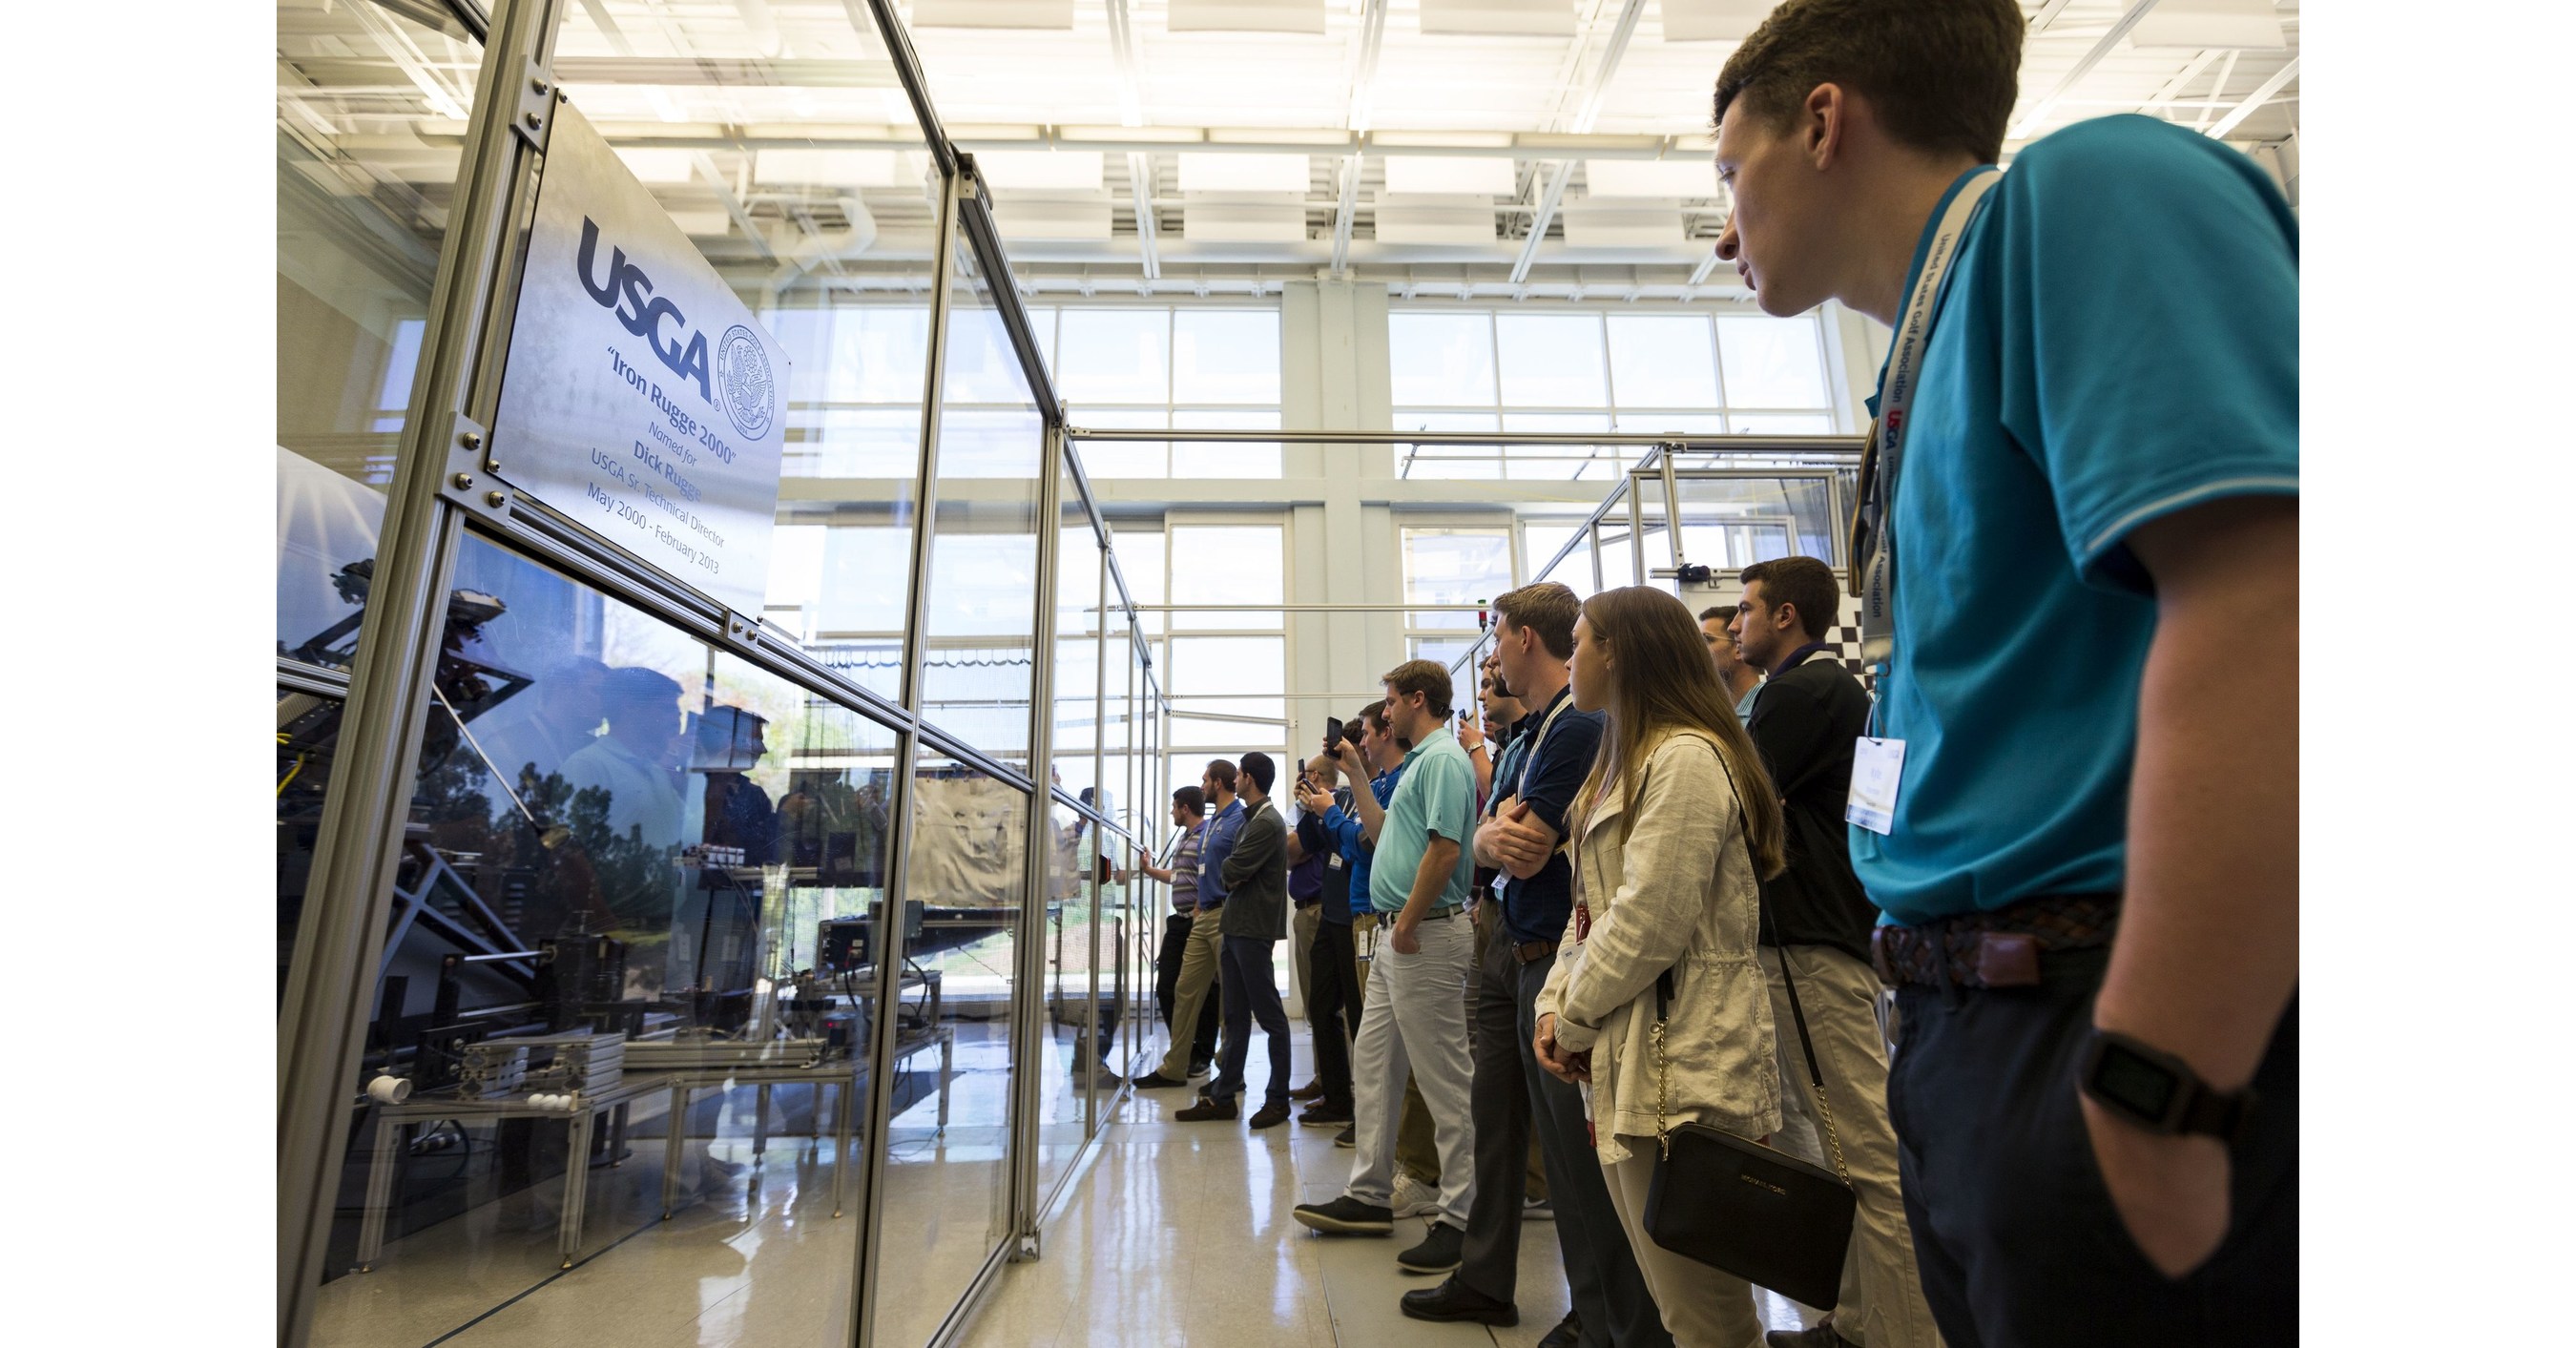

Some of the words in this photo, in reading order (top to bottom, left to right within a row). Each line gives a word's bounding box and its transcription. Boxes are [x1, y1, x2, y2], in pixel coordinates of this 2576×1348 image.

[1930, 233, 1952, 271] United
[577, 215, 712, 405] USGA
[1916, 271, 1936, 307] States
[719, 333, 733, 361] UNITED
[731, 328, 748, 339] STATES
[1907, 309, 1923, 334] Golf
[1892, 336, 1916, 403] Association
[650, 382, 697, 436] Rugge
[1885, 409, 1903, 450] USGA
[634, 440, 663, 475] Dick
[664, 463, 702, 502] Rugge
[648, 421, 684, 457] Named
[680, 448, 697, 467] for
[592, 447, 625, 483] USGA
[628, 473, 640, 493] Sr.
[644, 482, 690, 525] Technical
[690, 515, 725, 548] Director
[587, 482, 615, 512] May
[616, 500, 647, 529] 2000
[654, 524, 697, 564] February
[697, 551, 719, 574] 2013
[1872, 555, 1885, 618] Association
